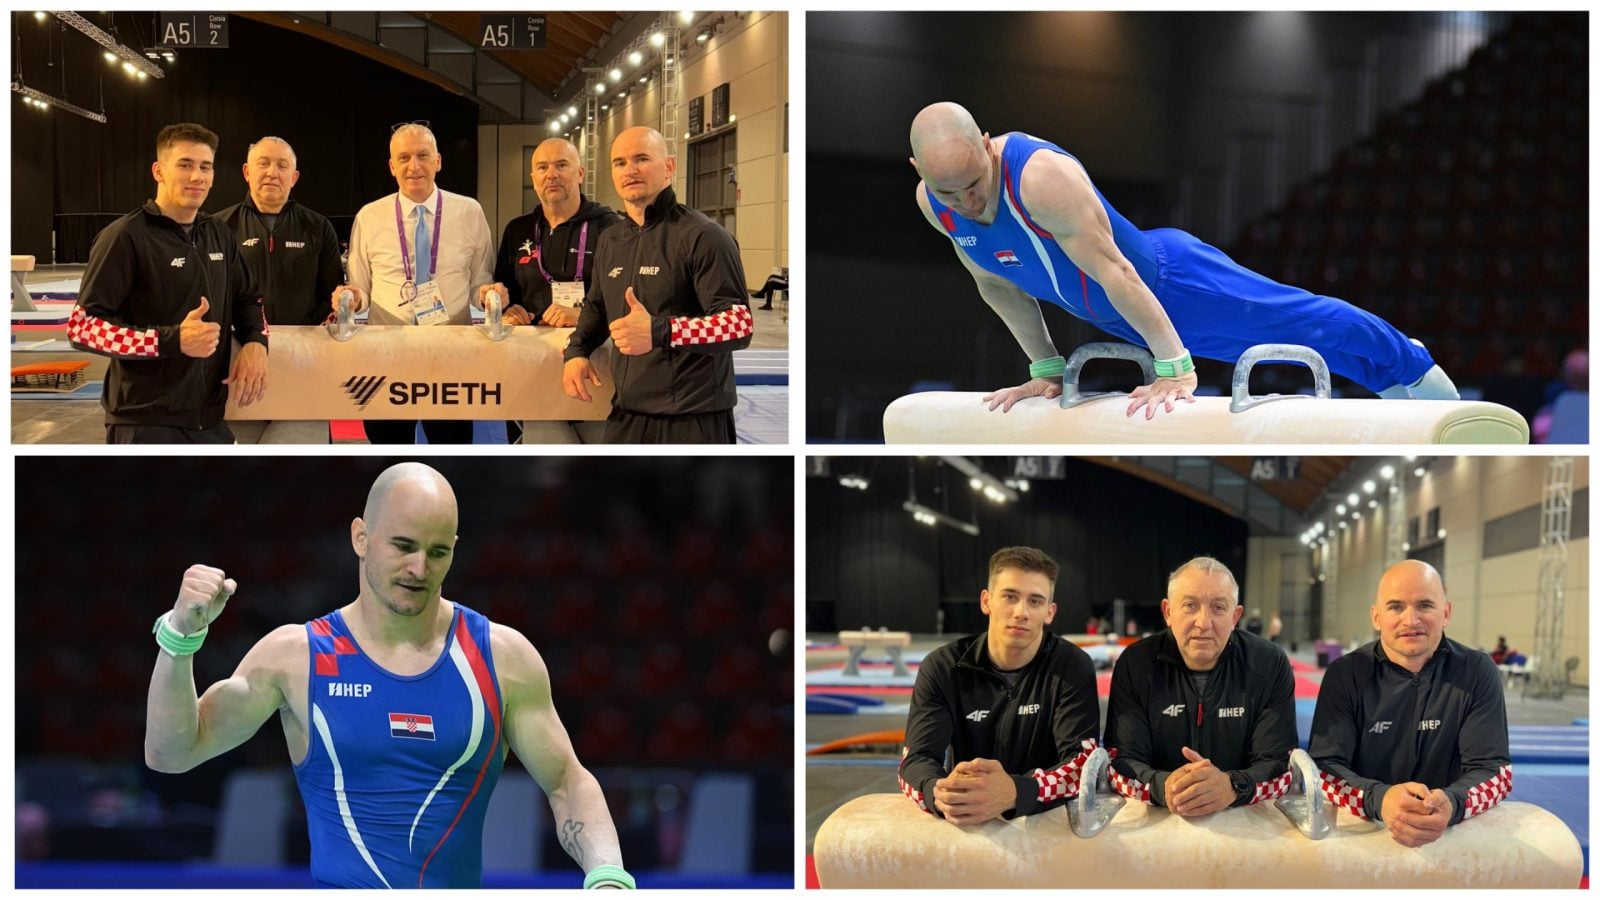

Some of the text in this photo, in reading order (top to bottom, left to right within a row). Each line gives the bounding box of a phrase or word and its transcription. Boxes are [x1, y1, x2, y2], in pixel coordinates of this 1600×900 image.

[163, 22, 190, 45] A5
[209, 30, 218, 45] 2
[481, 24, 509, 47] A5
[529, 32, 535, 47] 1
[389, 381, 502, 406] SPIETH
[343, 683, 372, 698] HEP
[966, 709, 991, 722] 4F
[1023, 703, 1040, 715] HEP
[1162, 704, 1186, 717] 4F
[1226, 707, 1245, 717] HEP
[1421, 719, 1441, 731] HEP
